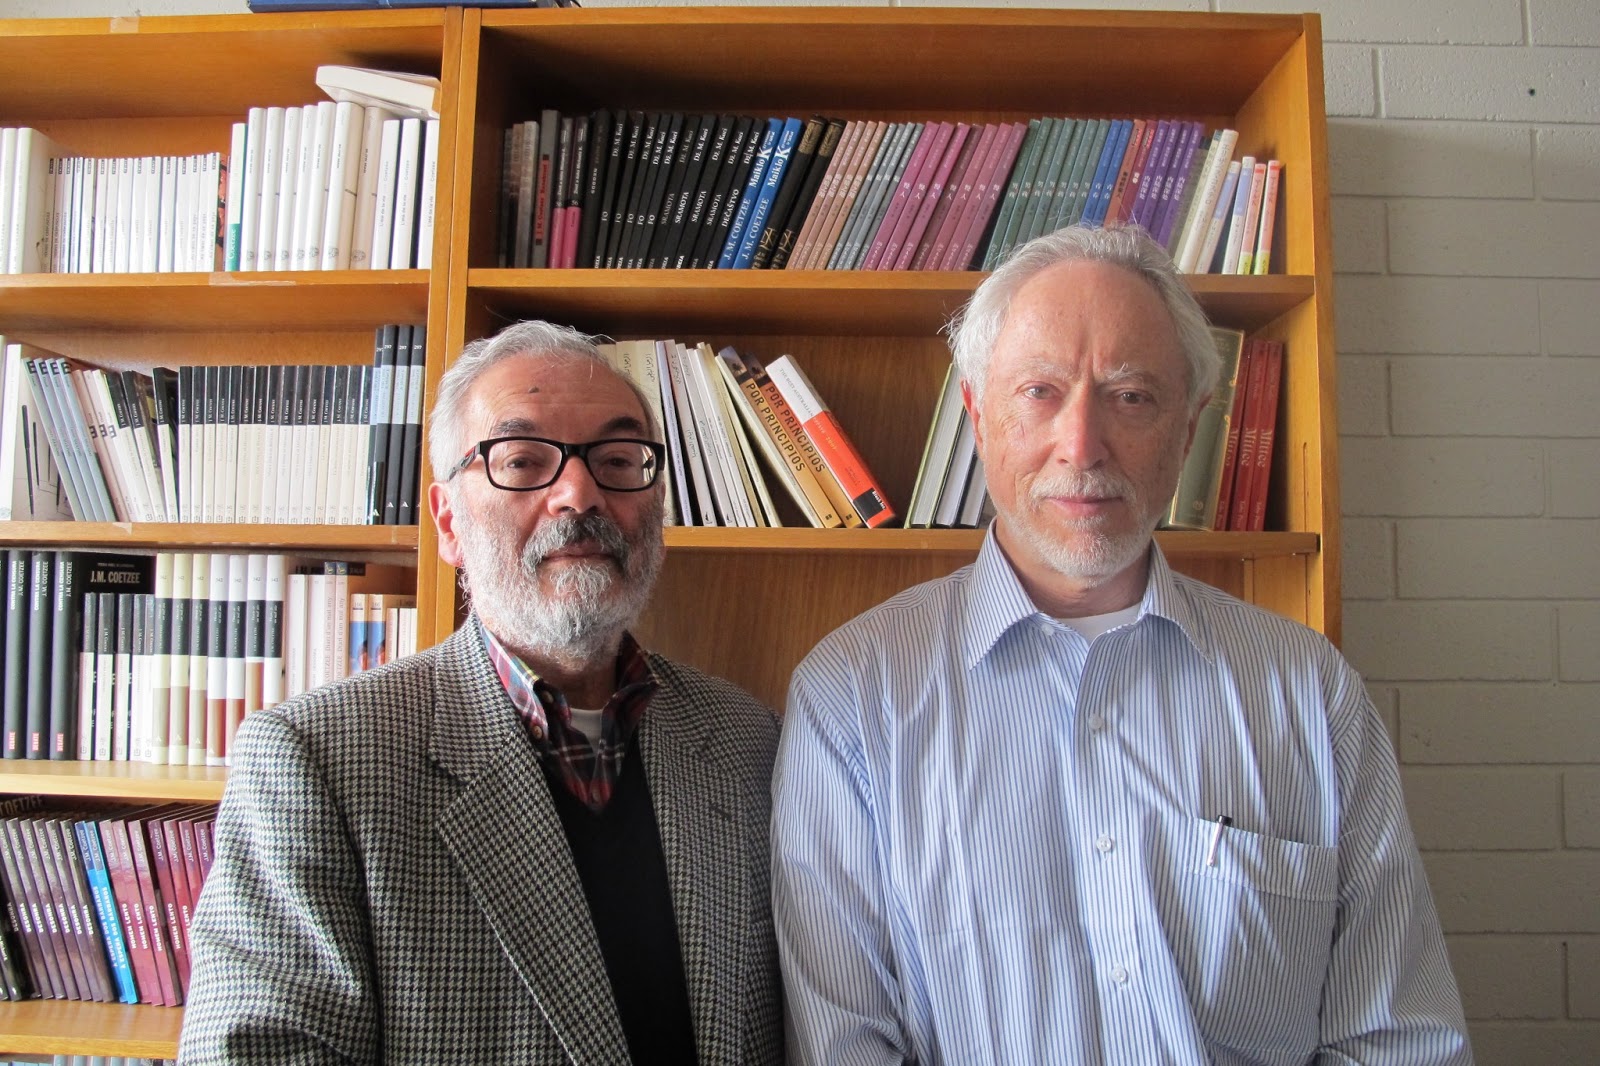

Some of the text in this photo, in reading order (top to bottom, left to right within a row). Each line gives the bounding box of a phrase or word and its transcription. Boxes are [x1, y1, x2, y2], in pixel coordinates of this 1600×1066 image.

[775, 146, 791, 160] K
[767, 159, 784, 187] Maiklo
[675, 192, 689, 223] SRAMOTA
[692, 191, 706, 222] SRAMOTA
[731, 199, 751, 239] COETZEE
[749, 159, 765, 188] Maiklo
[757, 146, 772, 160] K
[707, 194, 721, 225] SRAMOTA
[749, 198, 769, 238] COETZEE
[794, 390, 813, 416] AUSTRALIAN
[746, 383, 805, 472] POR PRINCIPIOS
[766, 386, 825, 473] POR PRINCIPIOS
[1241, 428, 1257, 466] Mittee
[1257, 429, 1272, 468] Mittee
[90, 571, 140, 583] J.M. COETZEE
[7, 902, 18, 932] DESONRA
[20, 903, 31, 932] DESONRA
[32, 903, 43, 932] DESONRA
[46, 903, 57, 933] DESONRA
[59, 903, 70, 933] DESONRA
[71, 905, 82, 934] DESONRA
[83, 905, 94, 935] DESONRA
[122, 904, 136, 949] HOMEM LENTO
[134, 904, 148, 949] HOMEM LENTO
[149, 906, 162, 951] HOMEM LENTO
[106, 936, 116, 961] ESPERA
[115, 937, 124, 962] ESPERA
[172, 926, 181, 949] HOMEM
